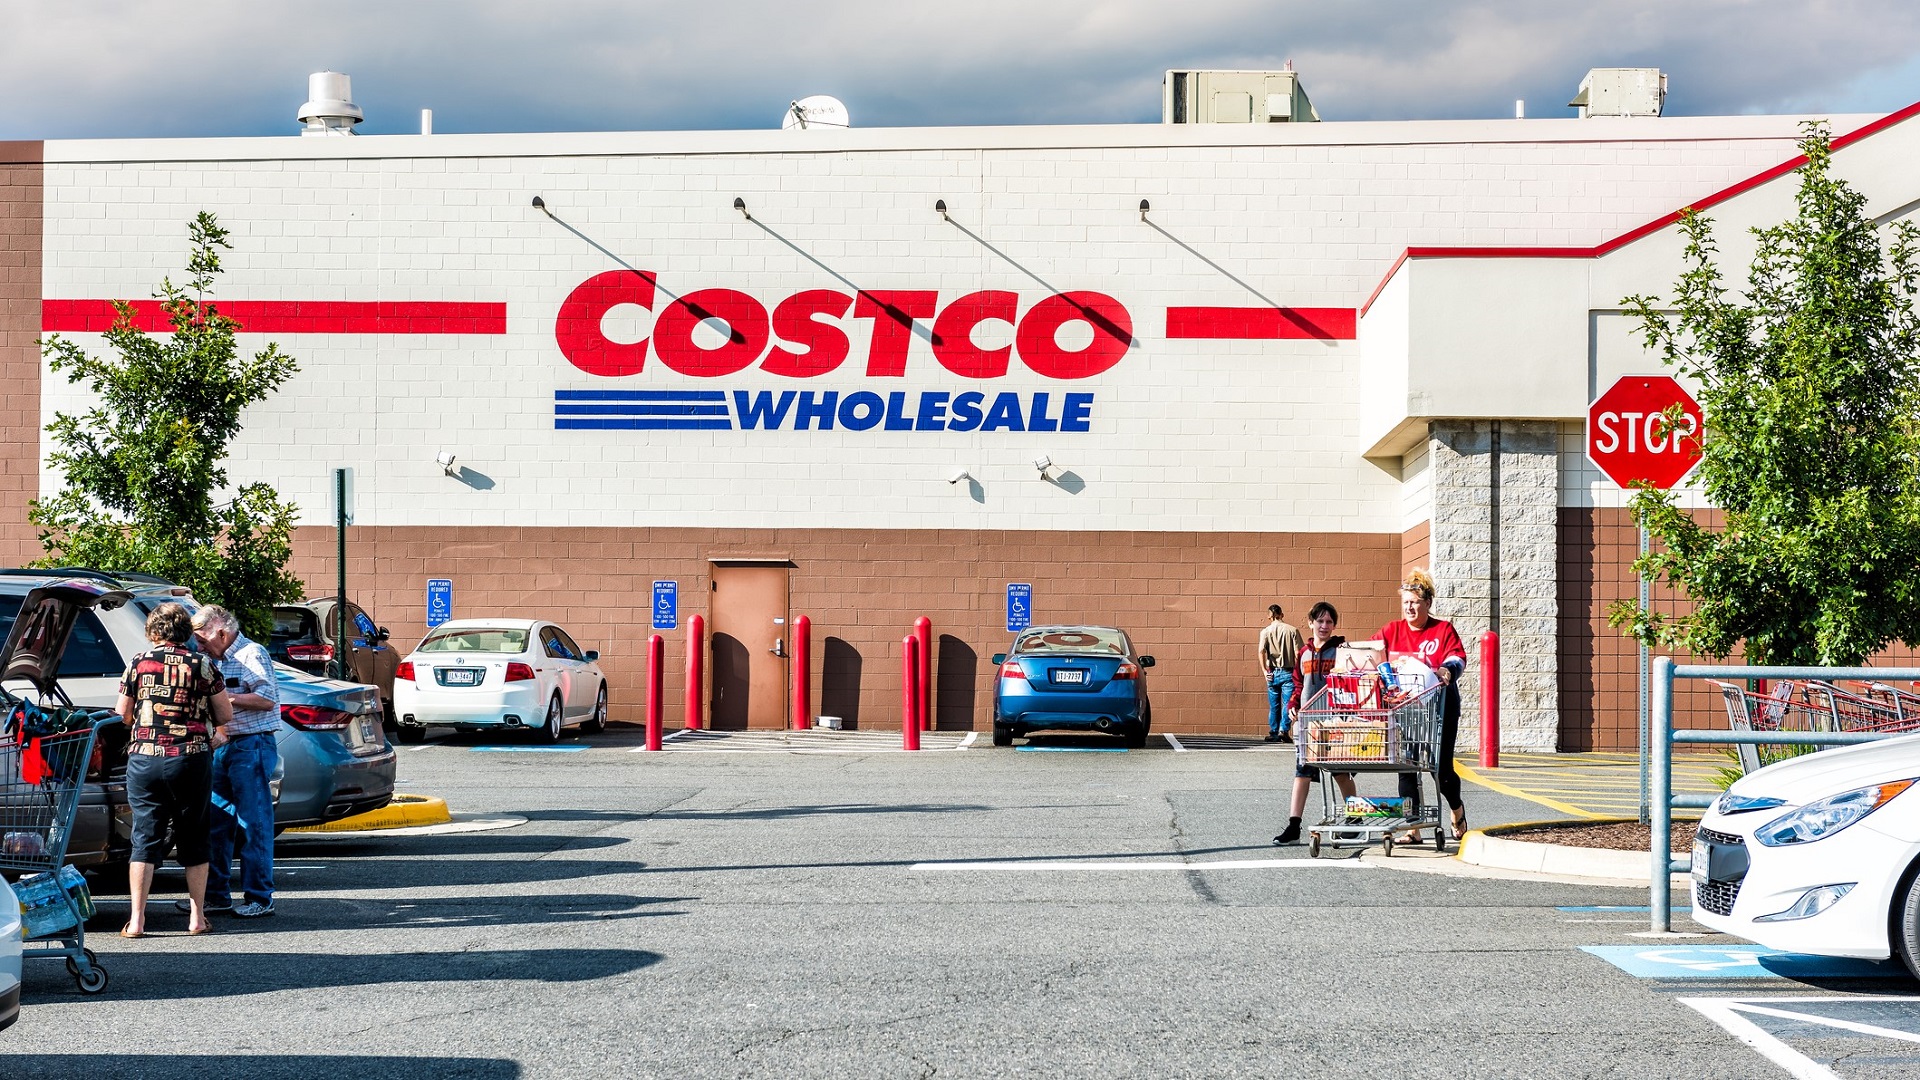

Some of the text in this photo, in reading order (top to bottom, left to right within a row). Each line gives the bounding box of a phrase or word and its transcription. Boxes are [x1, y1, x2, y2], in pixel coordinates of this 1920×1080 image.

[555, 269, 1134, 379] COSTCO
[732, 391, 1094, 432] WHOLESALE
[1595, 411, 1697, 454] STOP
